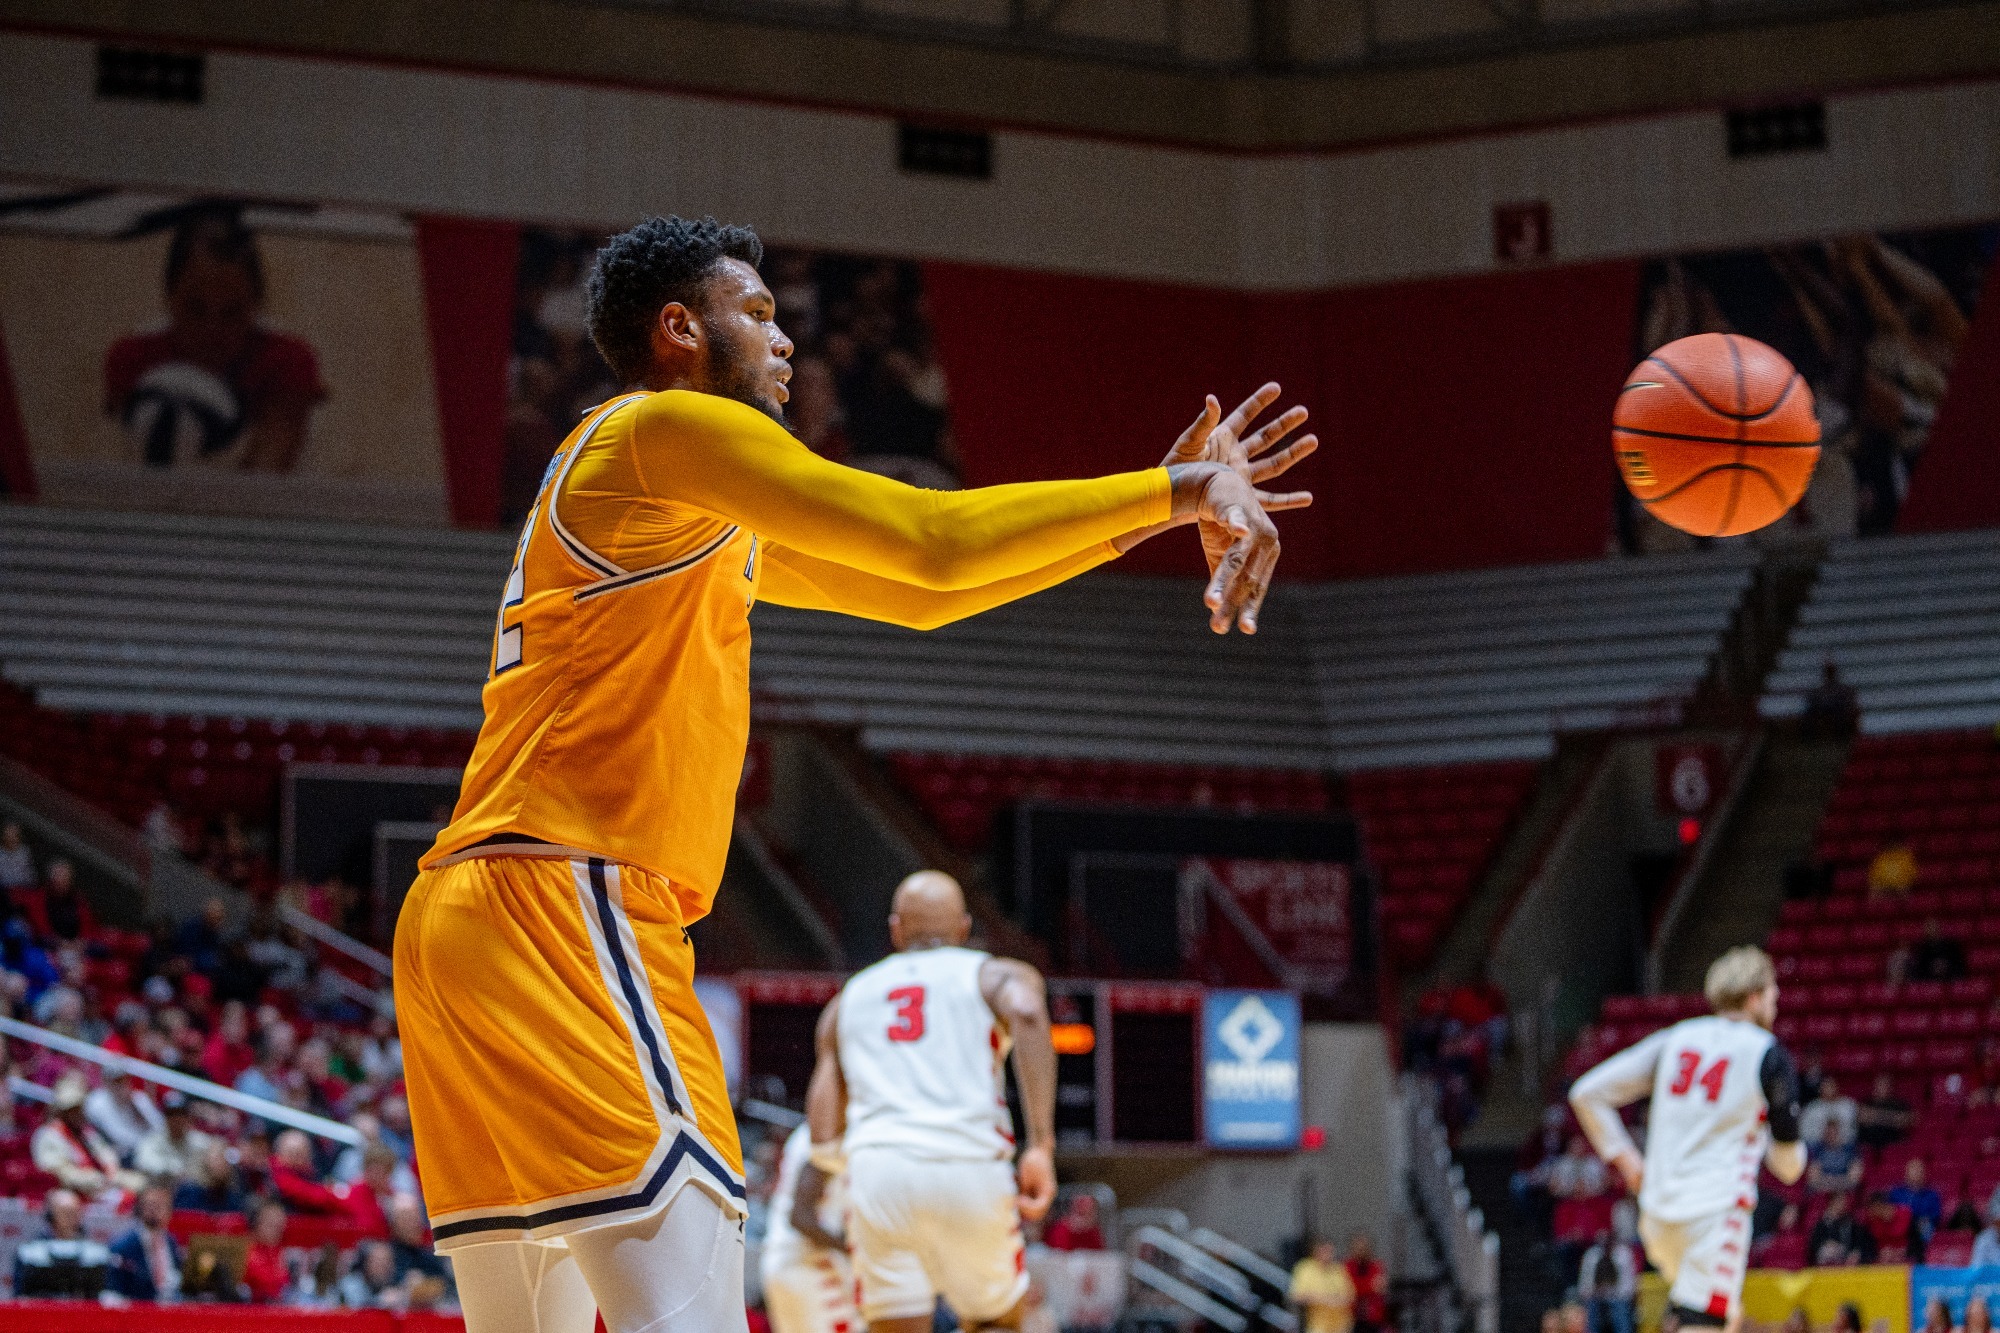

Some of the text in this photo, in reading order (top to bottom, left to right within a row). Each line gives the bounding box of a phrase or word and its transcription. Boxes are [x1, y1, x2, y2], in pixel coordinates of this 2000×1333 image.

[1672, 757, 1709, 811] 6
[887, 985, 926, 1043] 3
[1670, 1051, 1730, 1103] 34
